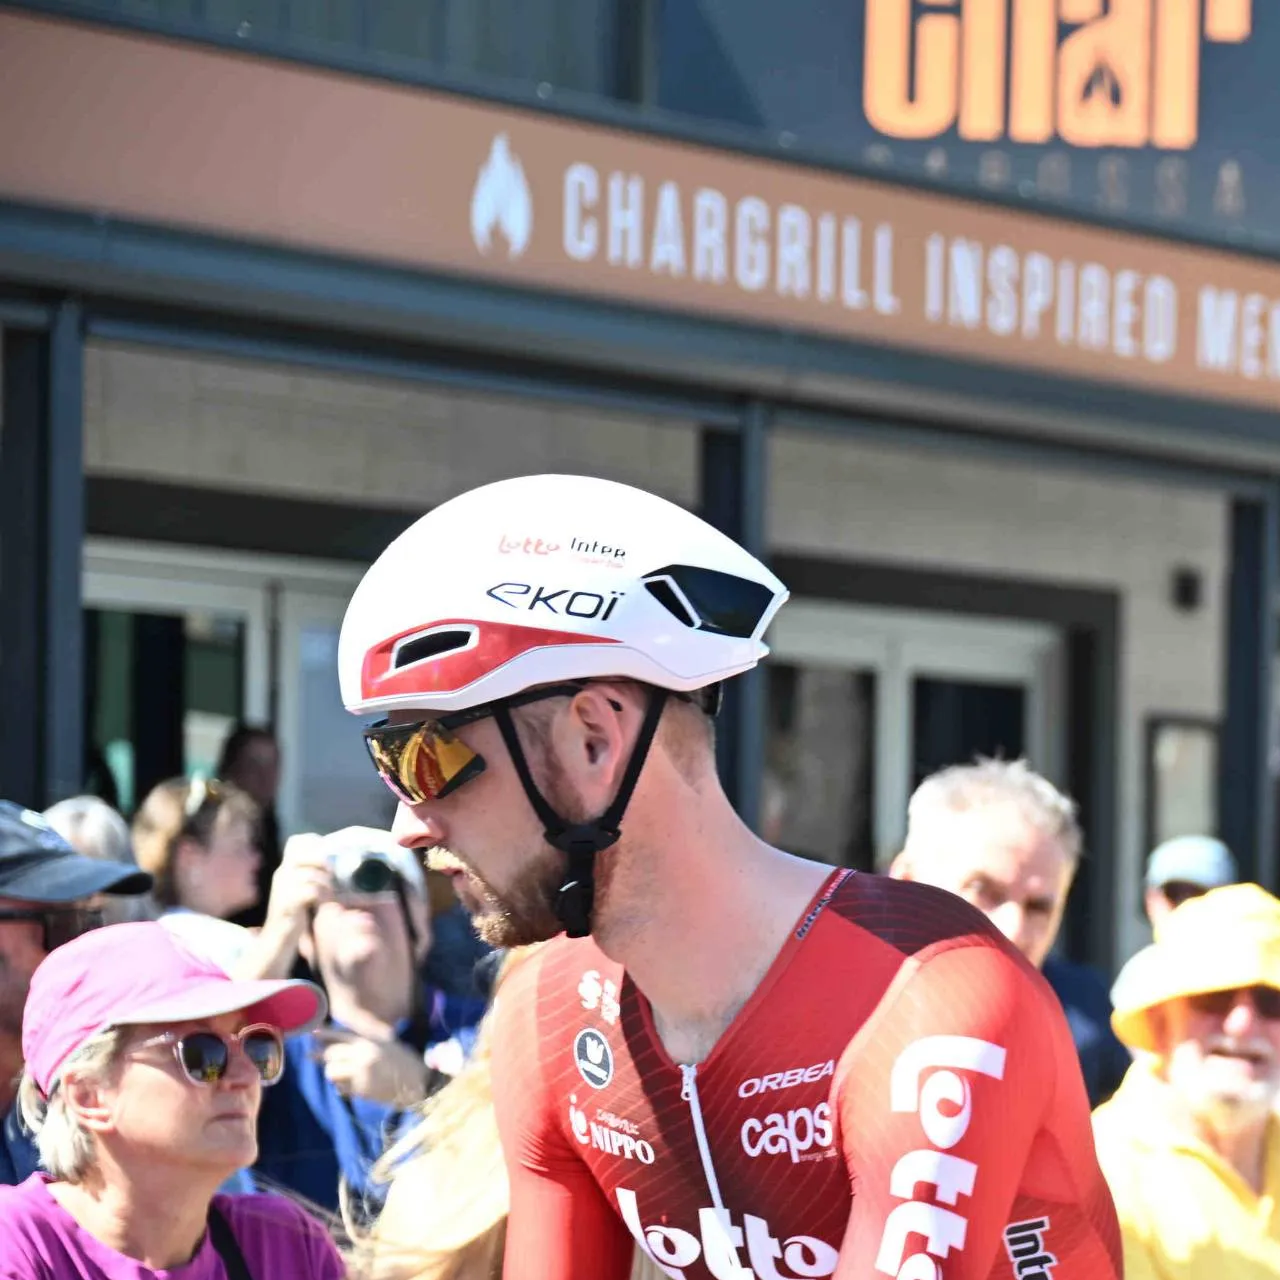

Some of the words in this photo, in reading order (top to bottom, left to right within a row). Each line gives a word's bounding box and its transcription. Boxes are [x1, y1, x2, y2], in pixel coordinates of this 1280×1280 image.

[562, 162, 900, 315] CHARGRILL
[925, 233, 1178, 364] INSPIRED
[737, 1060, 835, 1099] ORBEA
[591, 1121, 656, 1165] NIPPO
[740, 1101, 834, 1164] caps
